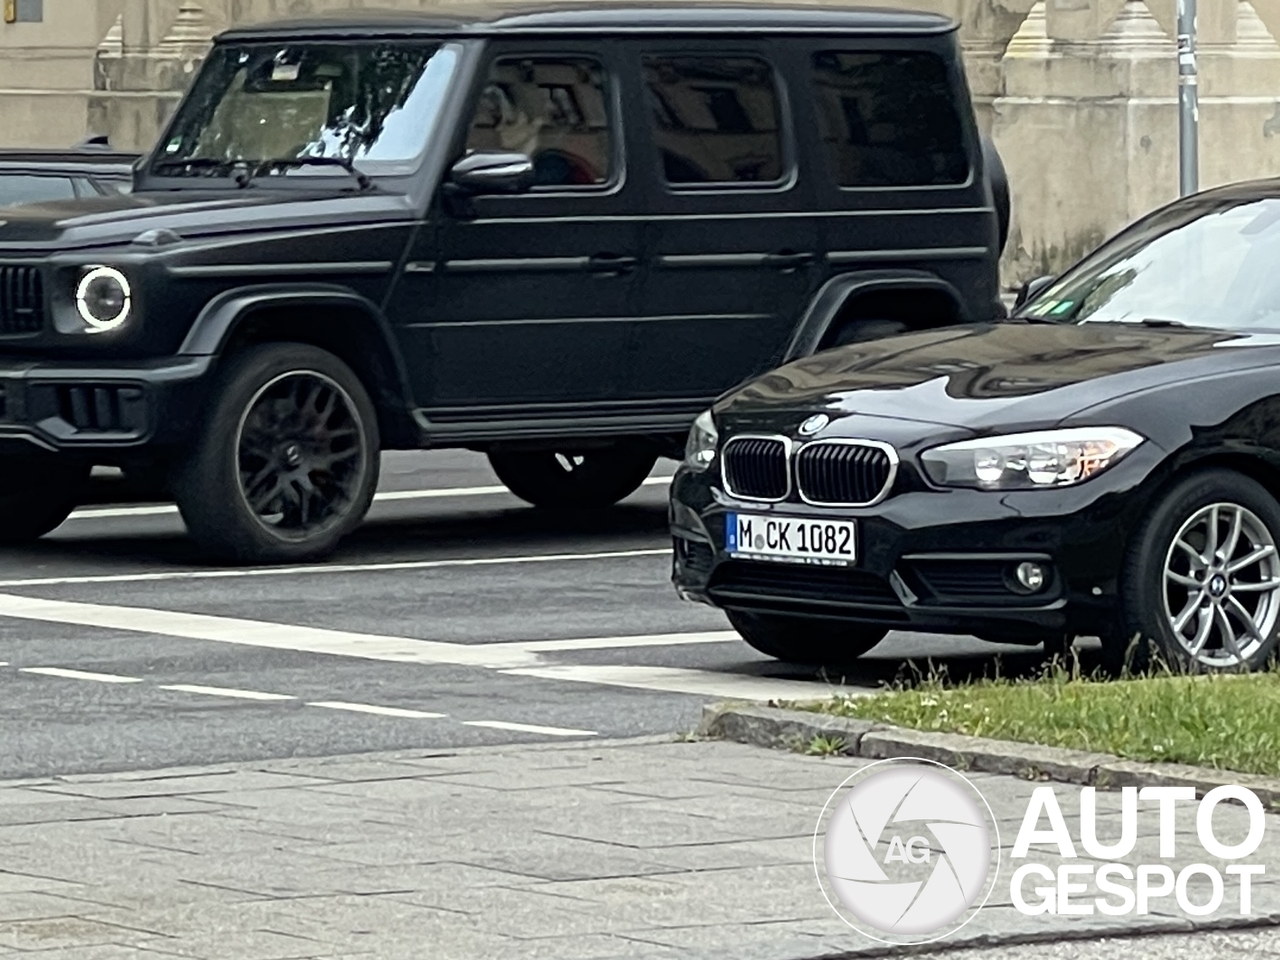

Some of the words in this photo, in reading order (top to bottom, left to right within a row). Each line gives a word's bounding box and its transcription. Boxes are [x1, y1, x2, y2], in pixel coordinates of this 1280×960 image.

[739, 519, 753, 548] M
[766, 521, 791, 551] CK
[796, 523, 852, 555] 1082
